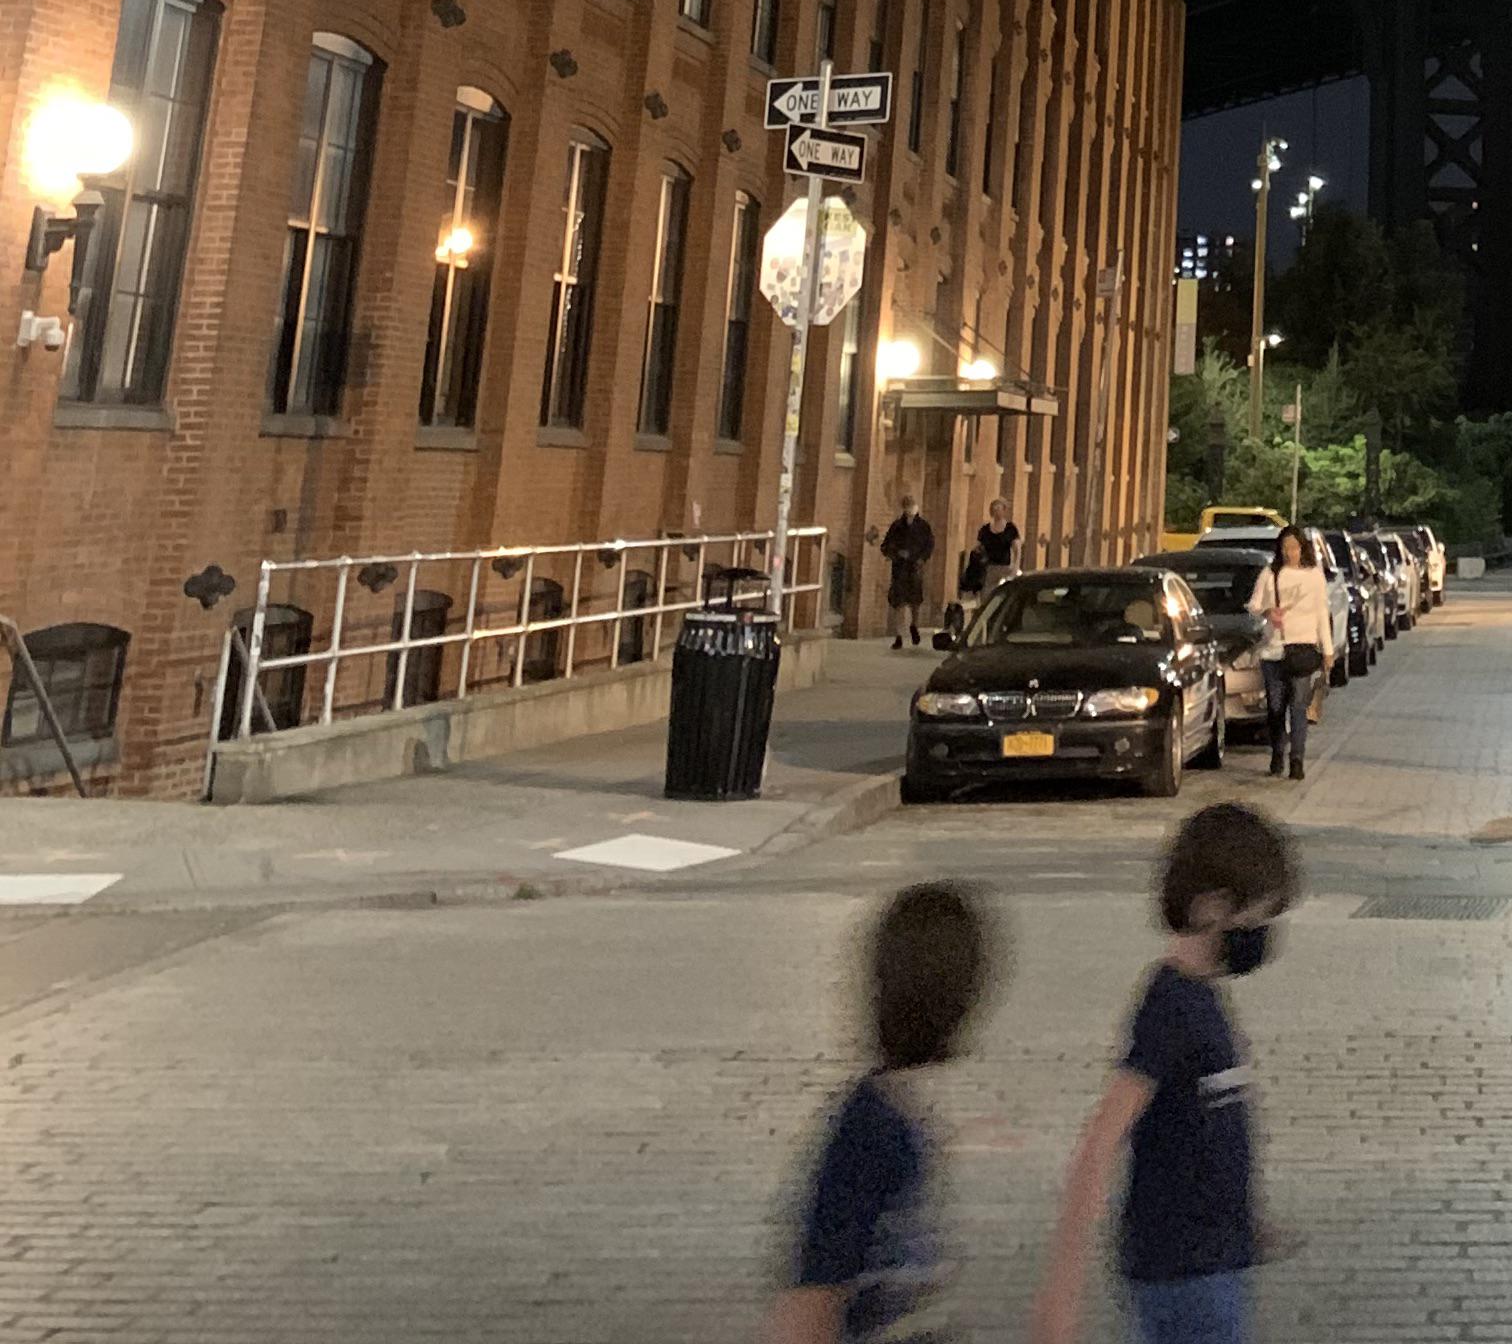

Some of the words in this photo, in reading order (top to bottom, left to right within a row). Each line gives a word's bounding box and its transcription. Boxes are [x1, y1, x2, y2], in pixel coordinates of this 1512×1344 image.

[786, 93, 819, 112] ONE
[837, 90, 873, 108] WAY
[798, 140, 821, 160] ONE
[831, 146, 855, 166] WAY
